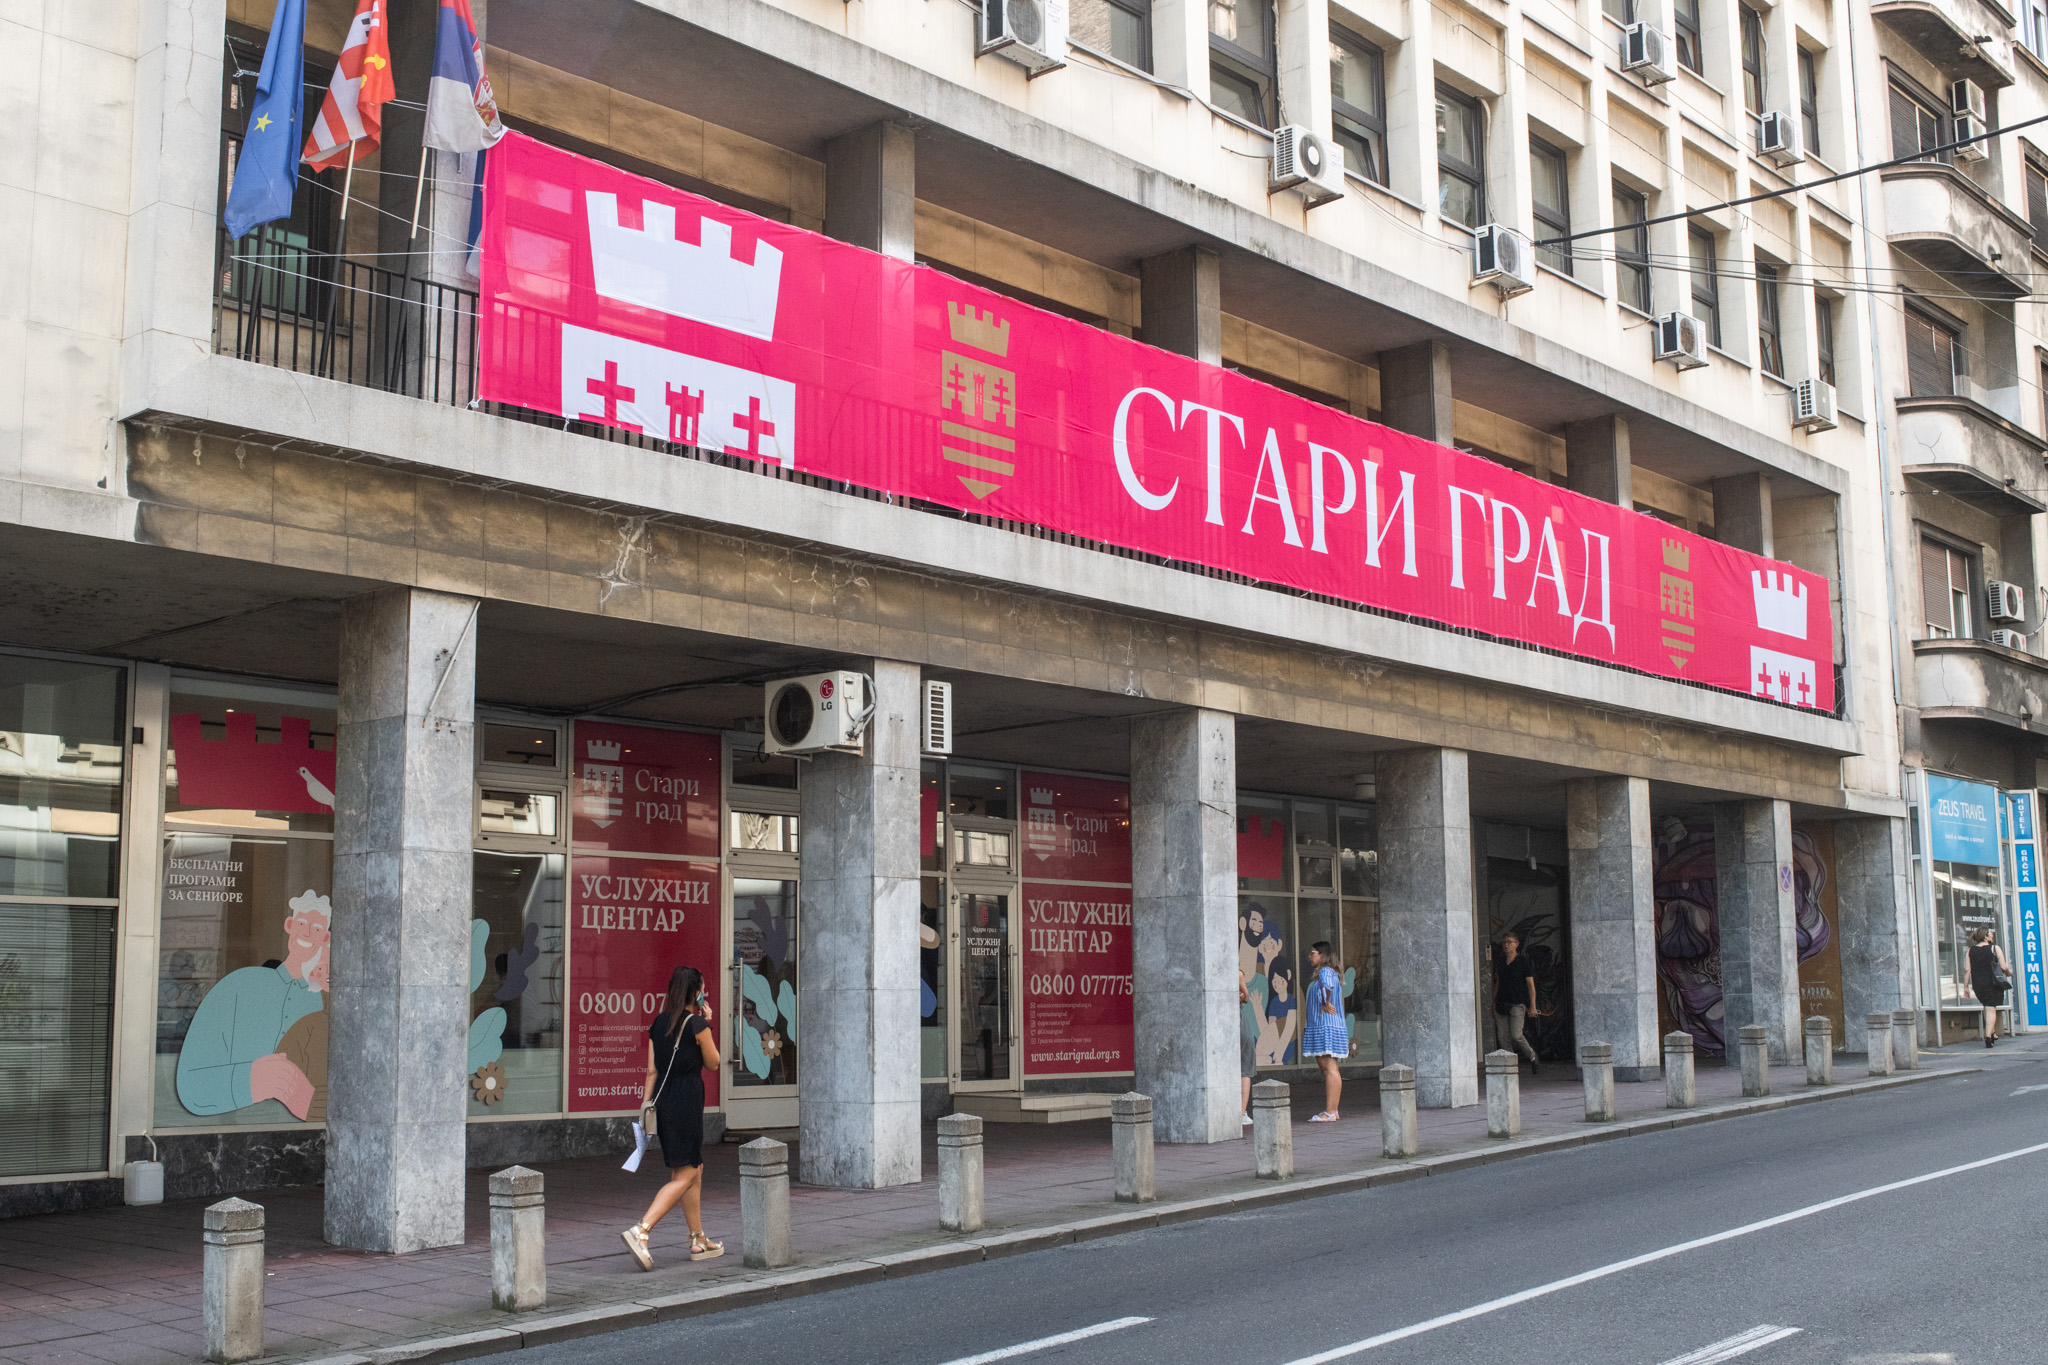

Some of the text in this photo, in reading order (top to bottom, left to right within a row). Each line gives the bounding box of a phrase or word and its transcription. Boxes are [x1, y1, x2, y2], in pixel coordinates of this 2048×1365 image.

[1113, 387, 1616, 655] СТАРИ ГРАД
[821, 701, 833, 711] LG
[635, 769, 699, 800] Стари
[635, 801, 683, 825] град
[1938, 799, 1960, 818] ZEUS
[1960, 802, 1987, 822] TRAVEL
[2017, 798, 2026, 835] HOTELI
[1063, 811, 1108, 837] Стари
[1064, 838, 1098, 857] град
[170, 858, 244, 873] БЕСПЛАТНИ
[2020, 849, 2030, 883] GRČKA
[169, 874, 236, 888] ПРОГРАМИ
[580, 874, 710, 905] УСЛУЖНИ
[168, 889, 243, 903] ЗА СЕНИОРЕ
[581, 905, 685, 935] ЦЕНТАР
[1028, 899, 1132, 926] УСЛУЖНИ
[967, 937, 1001, 946] УСЛУЖНИ
[971, 947, 999, 956] ЦЕНТАР
[1030, 929, 1113, 957] ЦЕНТАР
[2024, 910, 2040, 1005] APARTMANI
[1030, 974, 1134, 996] 0800 077775
[579, 992, 636, 1015] 0800
[1031, 1048, 1120, 1064] www.starigrad.org.rs
[578, 1082, 645, 1098] www.starig
